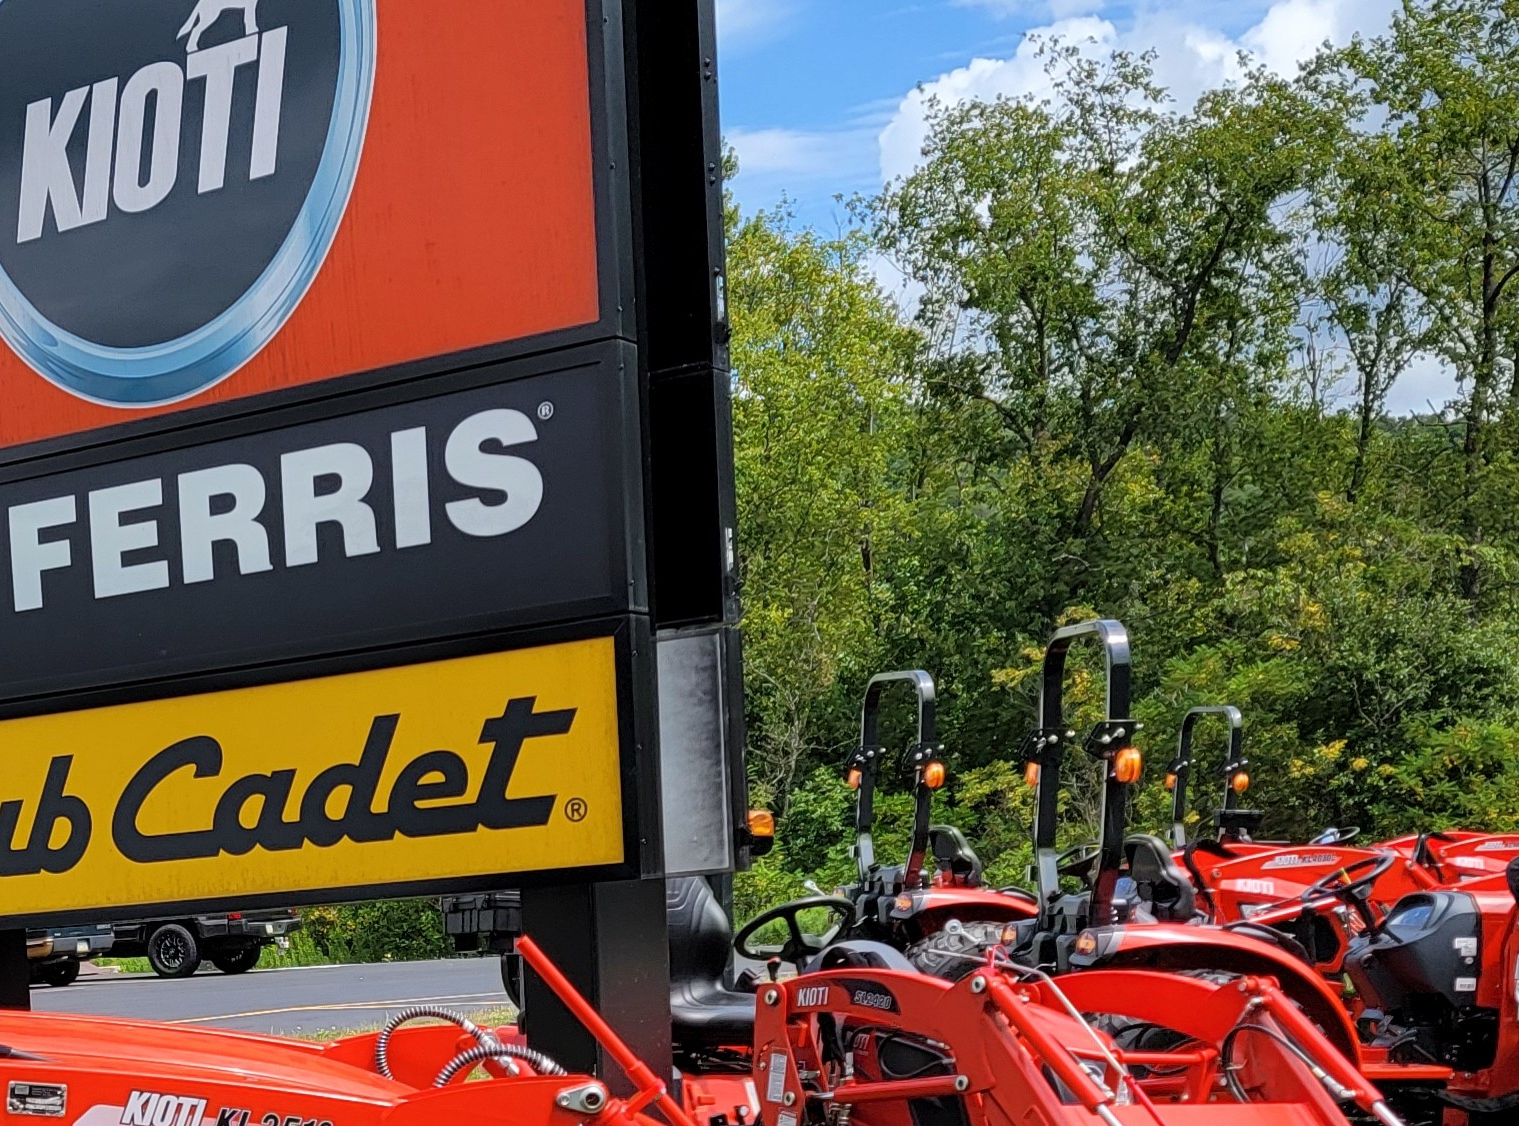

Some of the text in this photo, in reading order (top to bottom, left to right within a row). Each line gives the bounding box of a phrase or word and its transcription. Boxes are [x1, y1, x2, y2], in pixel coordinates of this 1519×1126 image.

[16, 26, 288, 244] KIOTI
[8, 408, 545, 612] FERRIS
[112, 695, 577, 863] Cadet
[797, 986, 829, 1007] KIOTI
[854, 990, 892, 1009] SL2420
